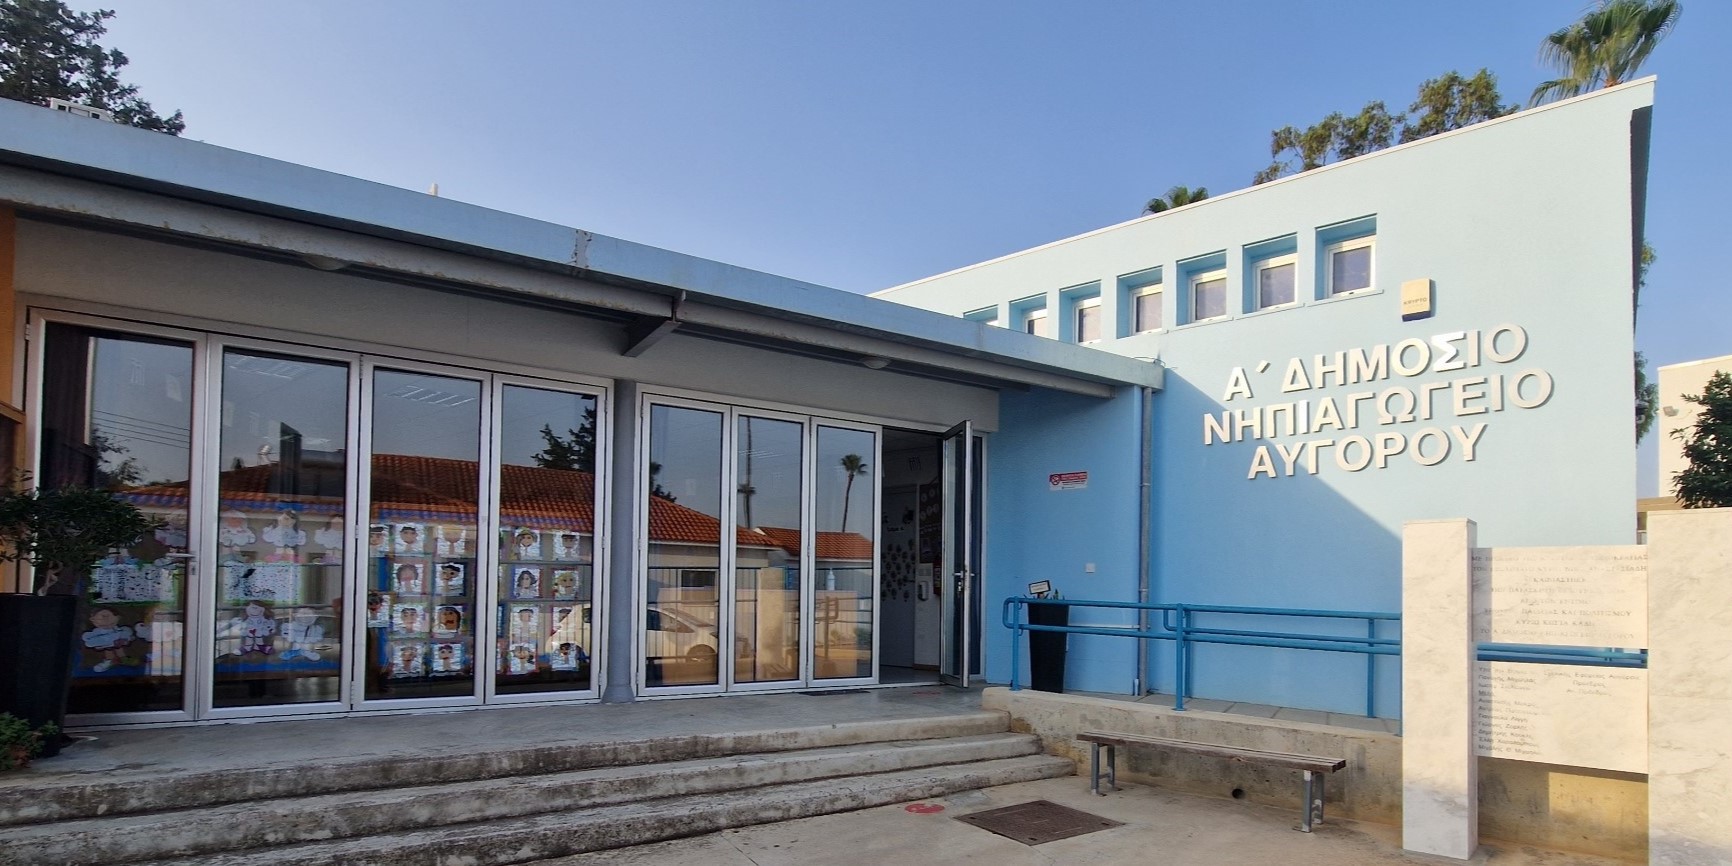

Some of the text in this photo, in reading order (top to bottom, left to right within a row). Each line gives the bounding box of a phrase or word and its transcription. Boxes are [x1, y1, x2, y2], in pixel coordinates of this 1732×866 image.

[1281, 323, 1528, 394] ΔΗΜΟΣΙΟ
[1203, 367, 1555, 446] ΝΗΠΙΑΓΩΓΕΙΟ
[1247, 422, 1489, 480] ΑΥΓΟΡΟΥ
